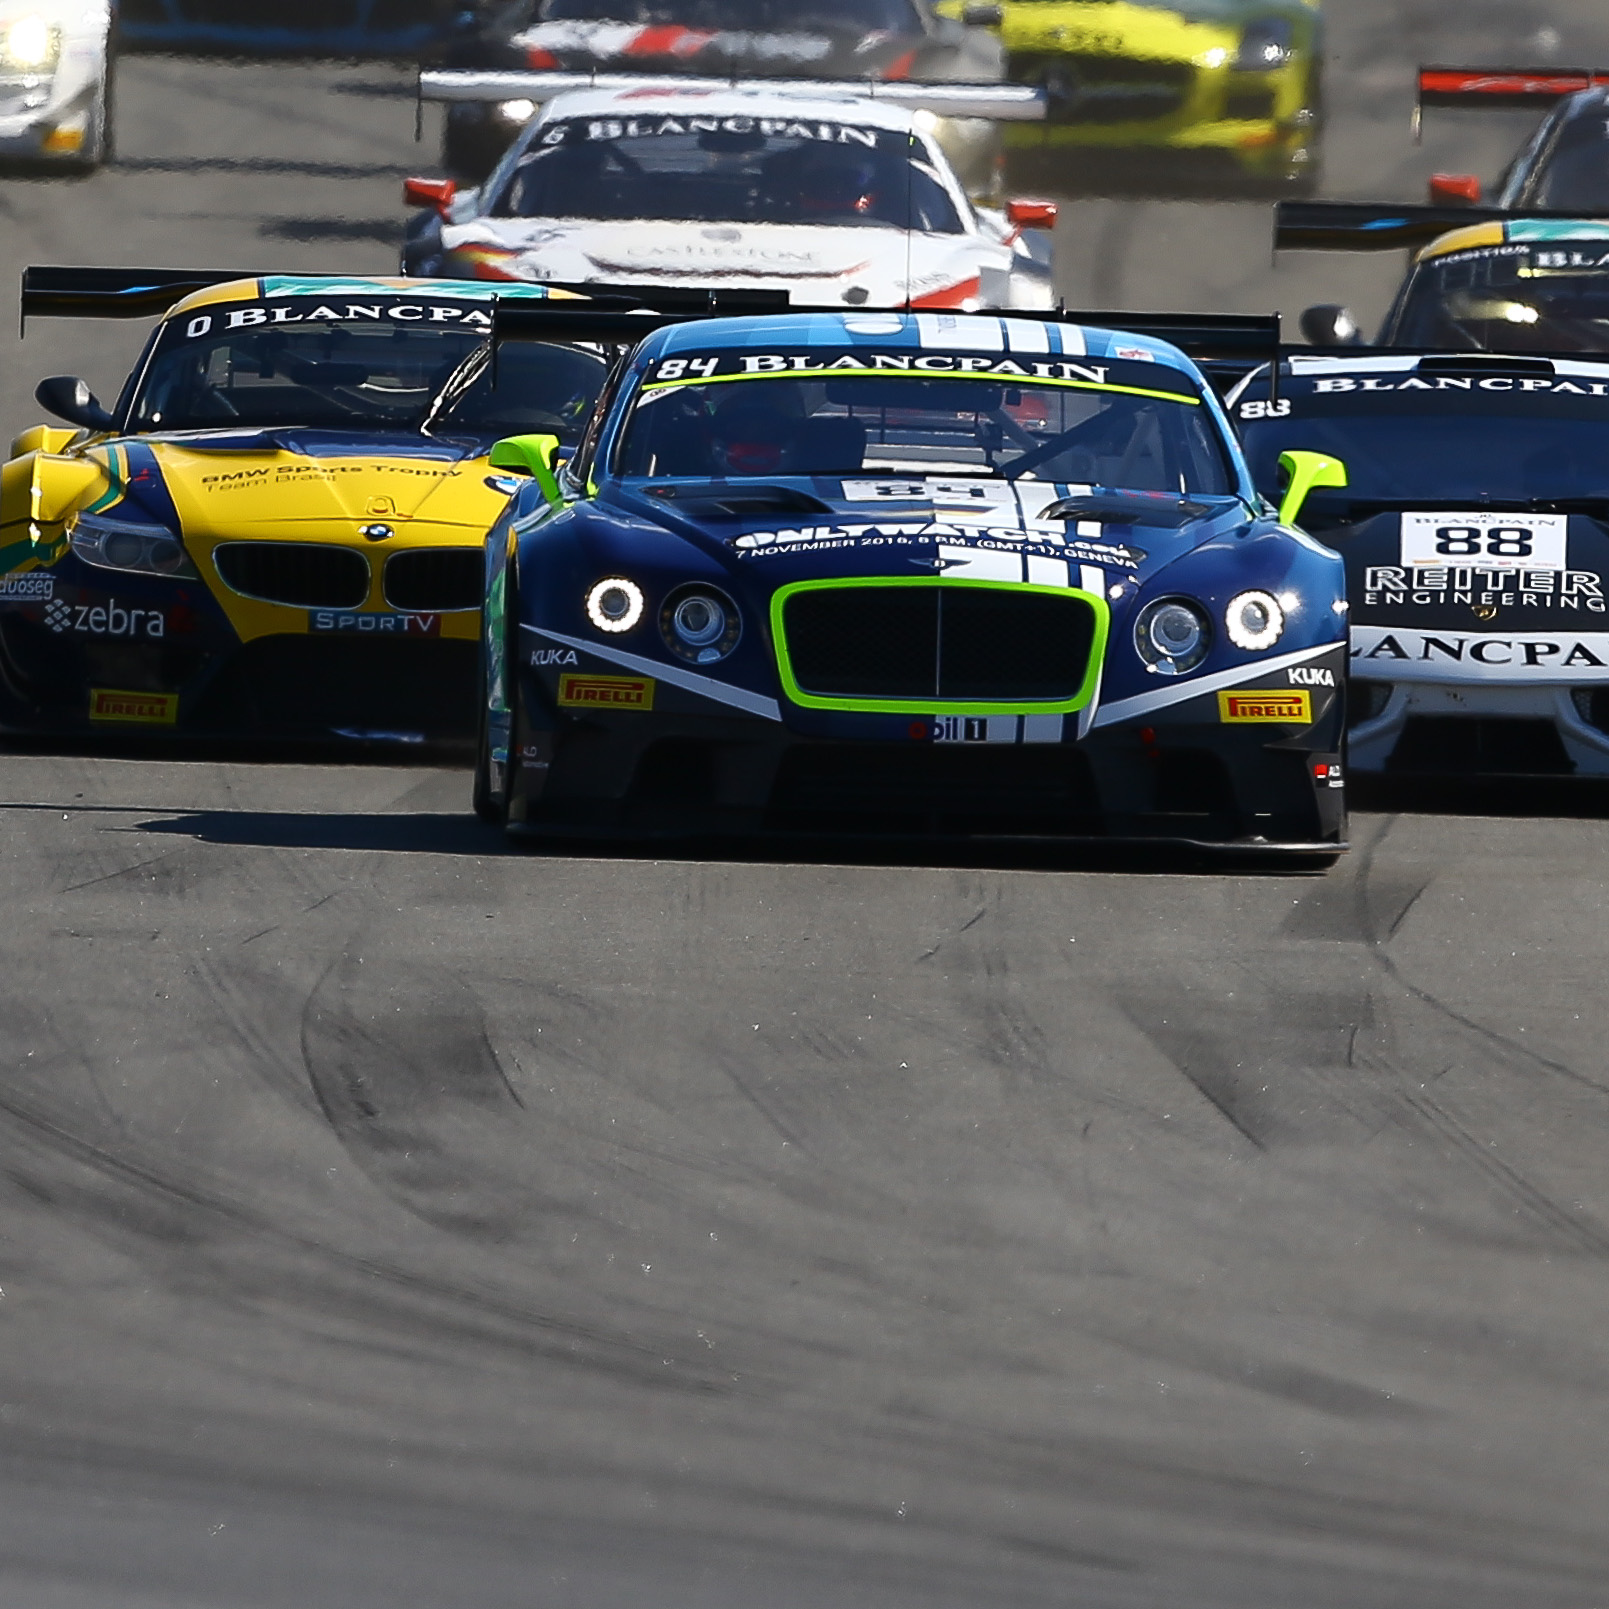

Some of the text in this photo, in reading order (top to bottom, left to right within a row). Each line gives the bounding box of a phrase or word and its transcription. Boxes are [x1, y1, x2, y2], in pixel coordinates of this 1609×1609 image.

[586, 117, 880, 149] BLANCPAIN
[224, 303, 493, 330] BLANCPA
[655, 356, 720, 380] 84
[739, 353, 1110, 385] BLANCPAIN
[751, 539, 856, 558] NOVEMBER
[1063, 548, 1140, 570] GENEVA
[1435, 526, 1534, 558] 88
[1363, 565, 1603, 598] REITER
[1364, 592, 1607, 614] ENGINEERING
[74, 598, 165, 637] zebra
[530, 650, 579, 665] KUKA
[1287, 667, 1335, 688] KUKA
[564, 678, 646, 704] PIRELLI
[95, 693, 169, 717] PIRELLI
[1228, 695, 1303, 717] PIRELLI
